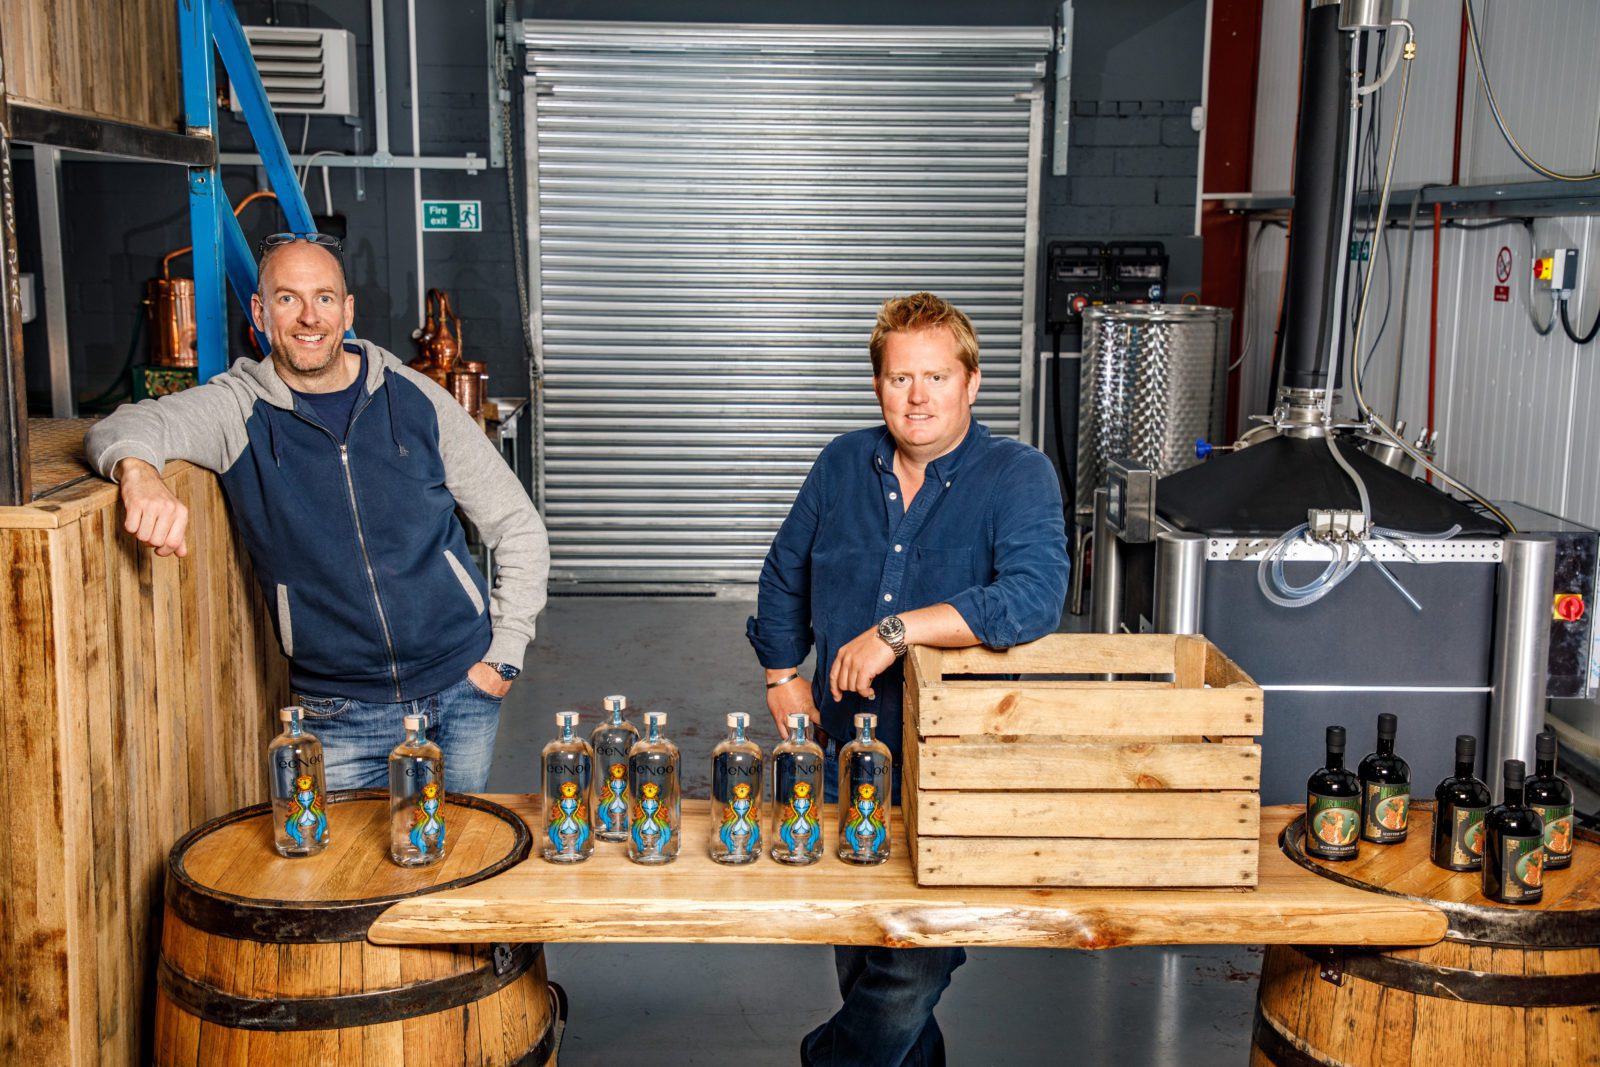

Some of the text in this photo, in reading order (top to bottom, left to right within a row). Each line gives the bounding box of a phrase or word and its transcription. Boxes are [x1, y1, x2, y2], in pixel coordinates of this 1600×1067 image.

[429, 206, 448, 215] Fire
[430, 217, 448, 225] exit
[596, 746, 631, 758] eeNo
[405, 763, 444, 777] eeNo
